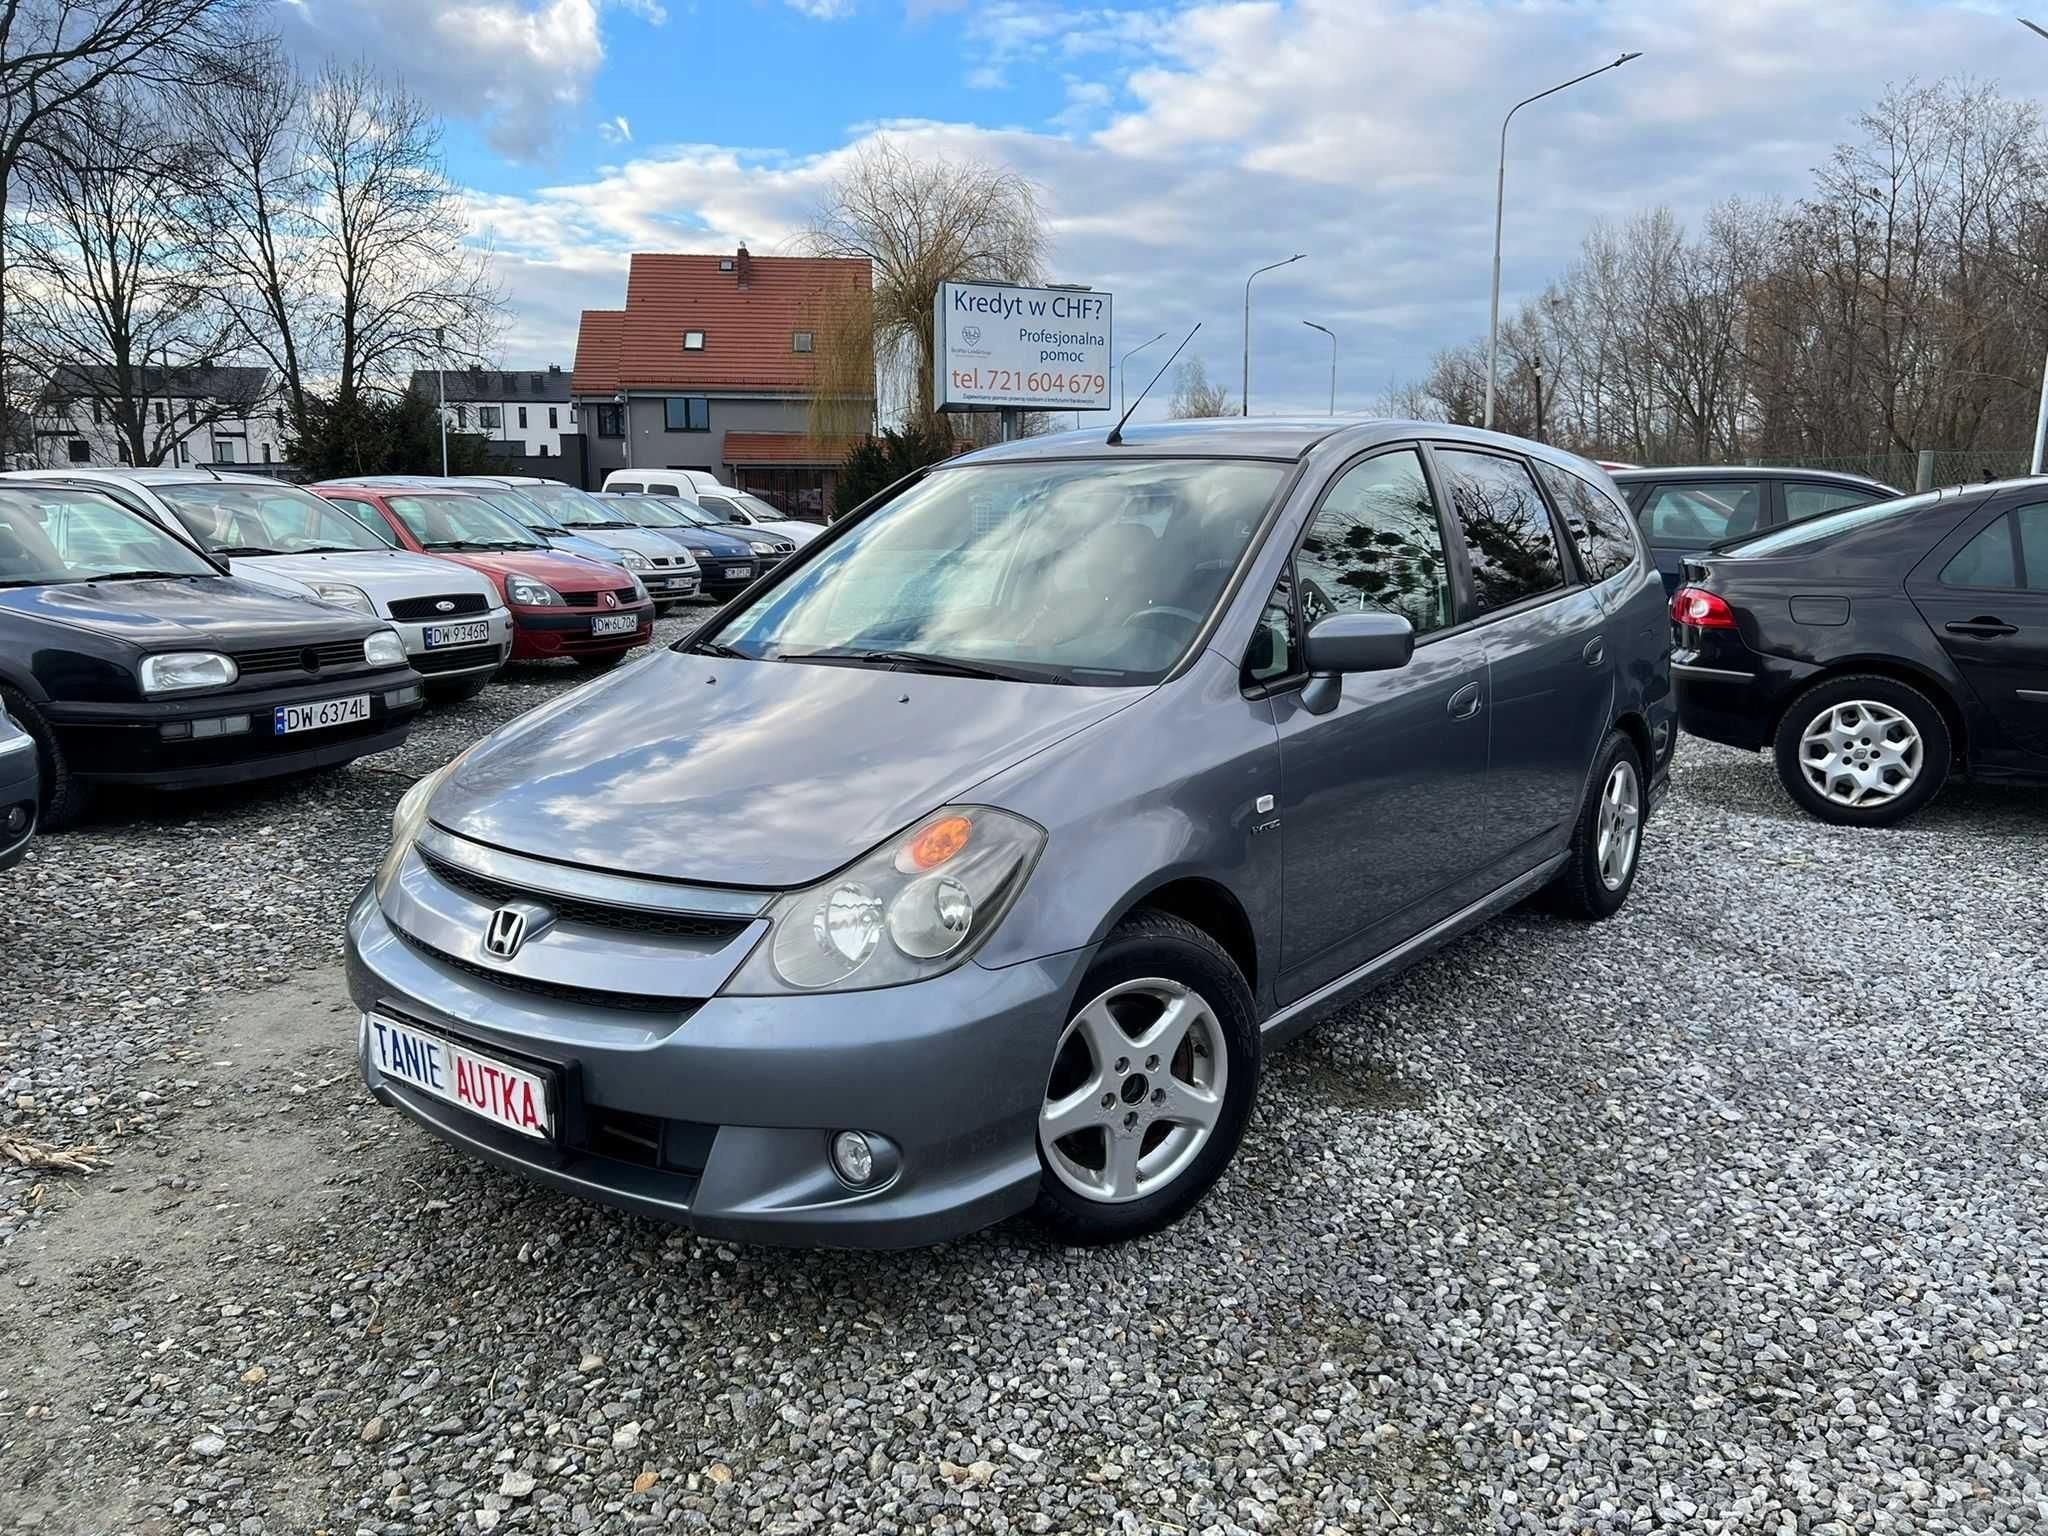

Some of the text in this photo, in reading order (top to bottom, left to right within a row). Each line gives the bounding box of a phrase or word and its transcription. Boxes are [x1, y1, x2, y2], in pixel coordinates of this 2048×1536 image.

[955, 290, 1103, 320] Kredyt w CHF?
[1019, 328, 1105, 347] Profesjonalna
[1040, 350, 1084, 363] pomoc
[952, 368, 1105, 394] tel. 721 604 679
[434, 623, 486, 644] DW 9346R
[287, 698, 368, 730] DW 6374L
[373, 1022, 540, 1130] TANIE AUTKA
